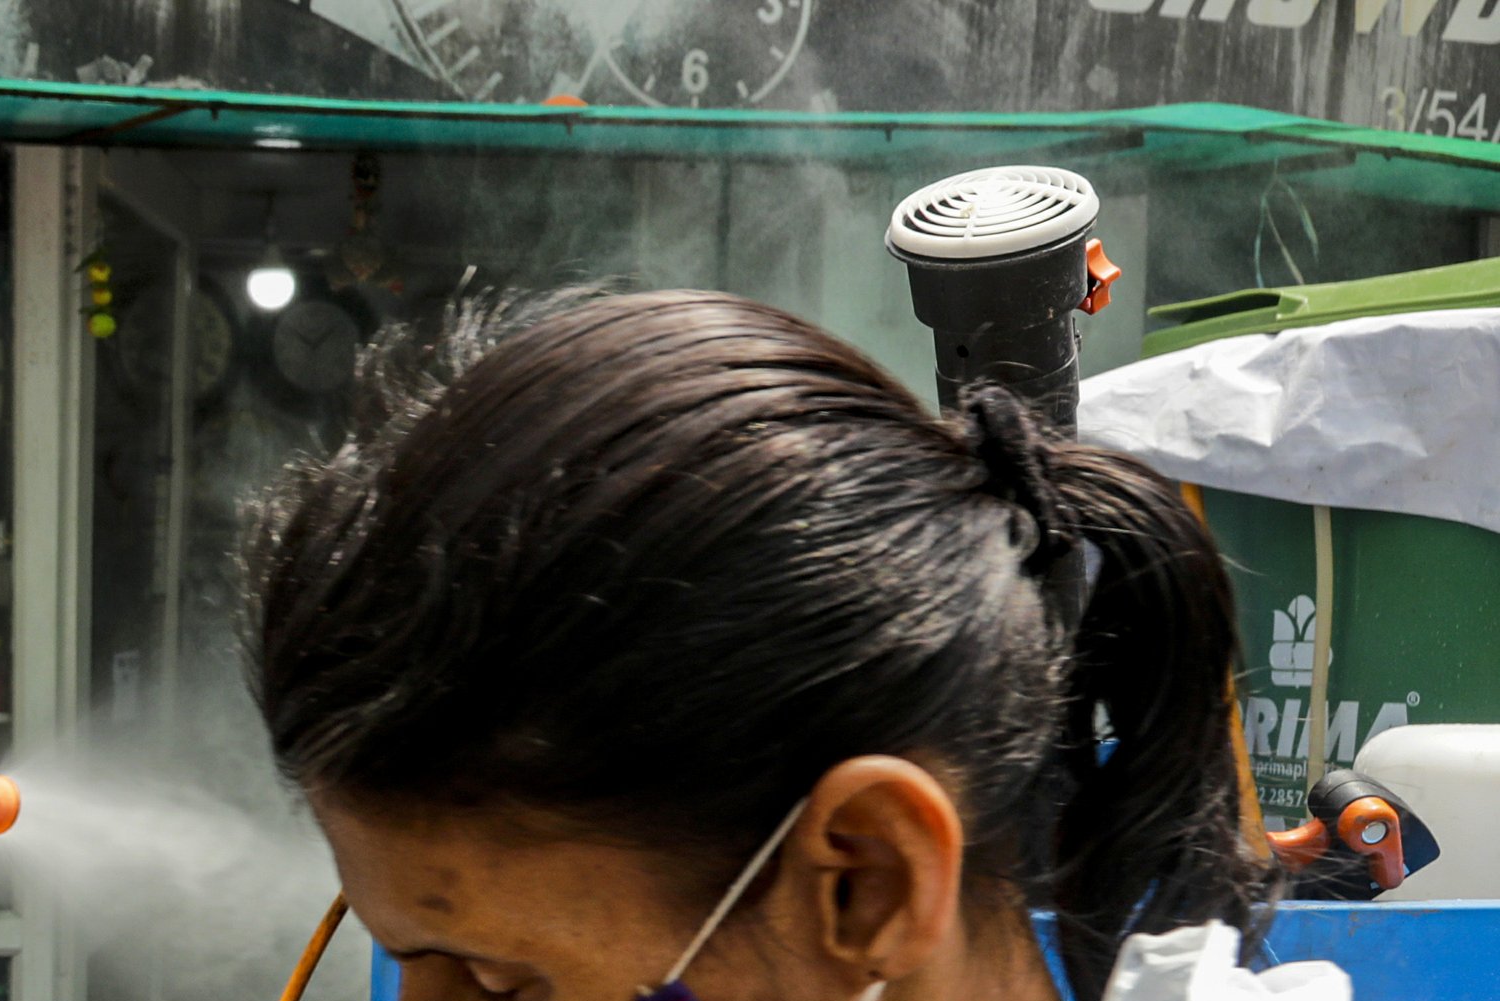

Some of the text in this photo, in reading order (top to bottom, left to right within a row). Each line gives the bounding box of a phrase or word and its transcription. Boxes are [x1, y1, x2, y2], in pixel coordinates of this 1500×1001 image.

[682, 48, 709, 93] 6
[1381, 86, 1500, 143] 3/54
[1268, 787, 1308, 808] 2857
